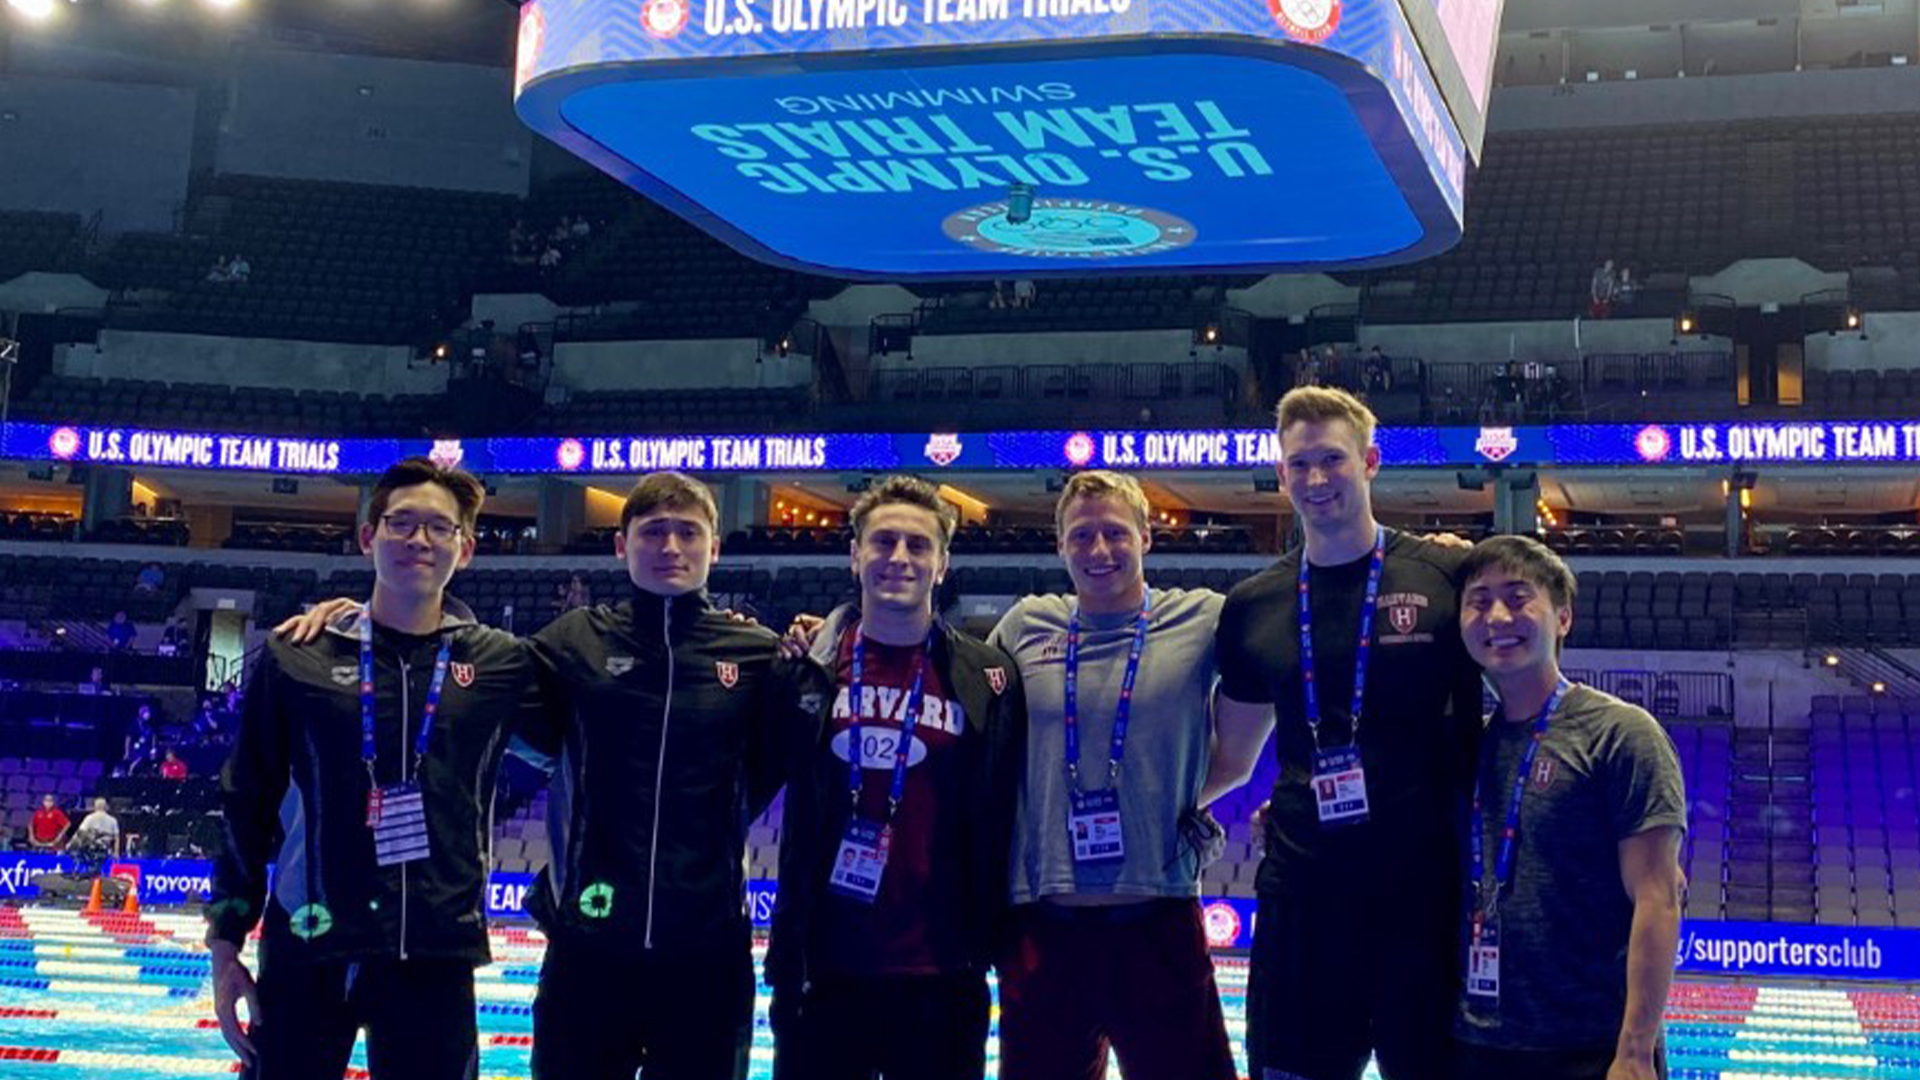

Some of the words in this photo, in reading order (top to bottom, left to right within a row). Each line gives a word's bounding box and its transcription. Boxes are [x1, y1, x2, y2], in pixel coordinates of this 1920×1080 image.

[704, 0, 762, 35] U.S.
[772, 0, 908, 33] OLYMPIC
[774, 82, 1076, 115] SWIMMING
[691, 114, 994, 160] TRIALS
[992, 101, 1250, 148] TEAM
[736, 152, 1089, 193] OLYMPIC
[1100, 142, 1273, 181] U.S.
[88, 431, 125, 460] U.S.
[129, 432, 213, 465] OLYMPIC
[219, 438, 271, 469] TEAM
[277, 440, 339, 470] TRIALS
[593, 439, 626, 468] U.S.
[629, 439, 705, 468] OLYMPIC
[711, 438, 760, 467] TEAM
[765, 437, 825, 466] TRIALS
[1103, 434, 1140, 463] U.S.
[1144, 433, 1228, 463] OLYMPIC
[1680, 427, 1723, 459] U.S.
[1728, 426, 1826, 459] OLYMPIC
[1832, 425, 1896, 457] TEAM
[1396, 607, 1411, 626] H
[832, 685, 965, 736] ARVARD
[145, 874, 212, 893] TOYOTA
